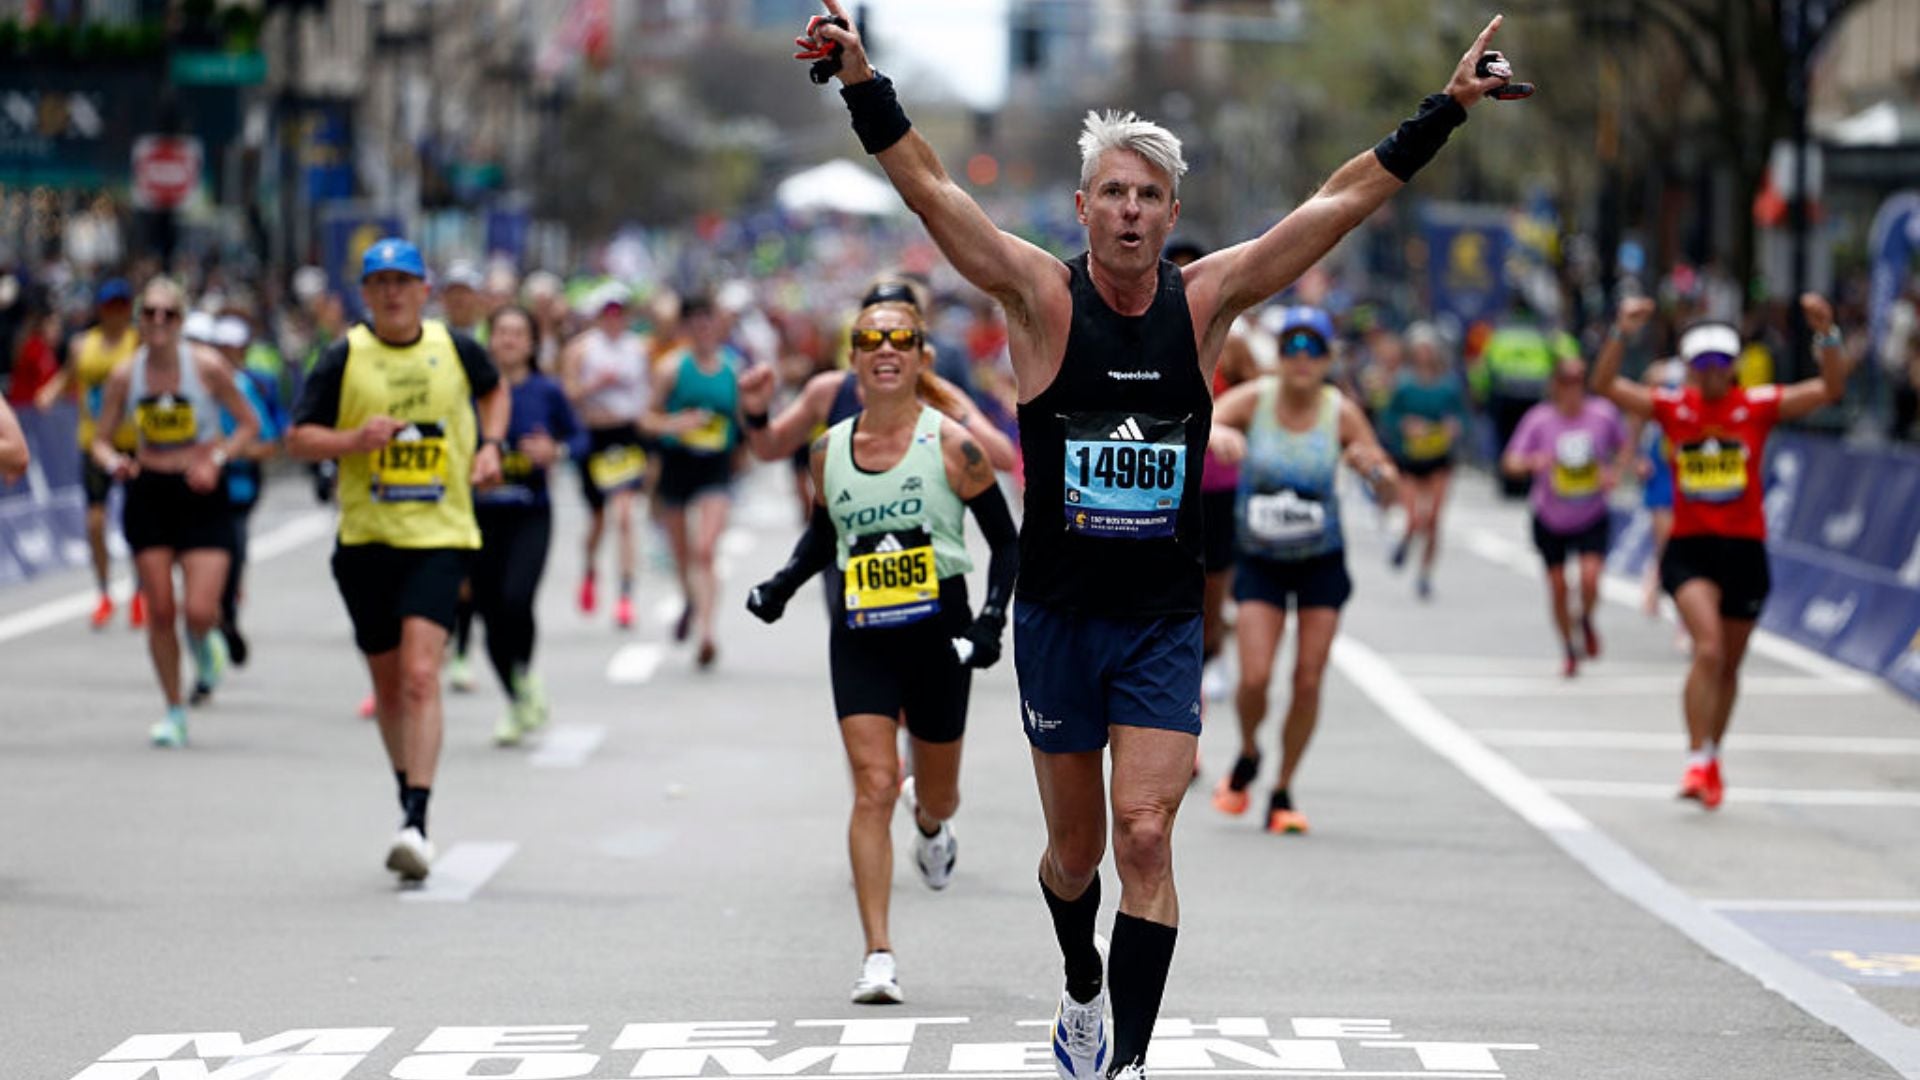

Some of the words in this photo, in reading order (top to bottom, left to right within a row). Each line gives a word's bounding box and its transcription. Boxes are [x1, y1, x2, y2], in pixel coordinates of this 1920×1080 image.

[1076, 446, 1176, 490] 14968
[840, 498, 922, 530] YOKO
[855, 553, 927, 591] 16695
[69, 1038, 1540, 1080] MOMENT
[97, 1017, 969, 1061] MEET
